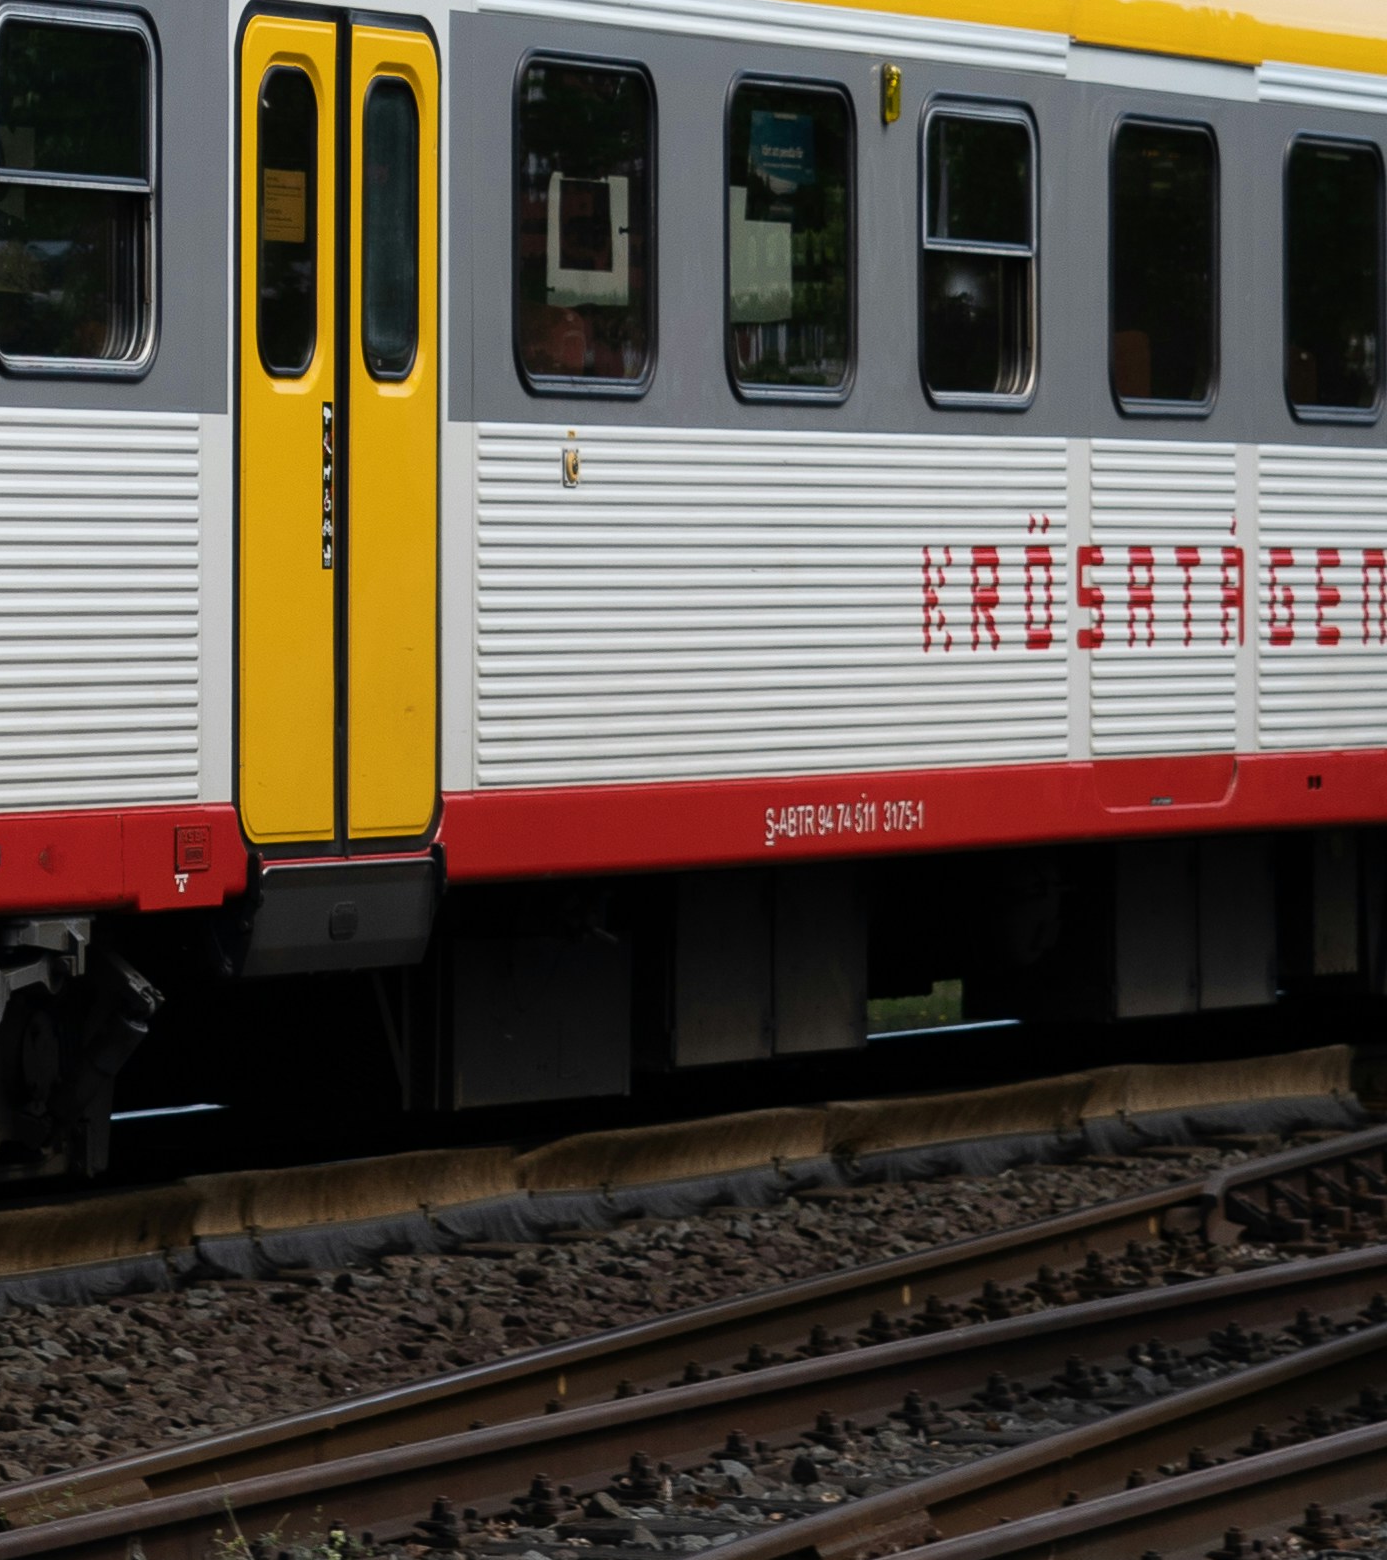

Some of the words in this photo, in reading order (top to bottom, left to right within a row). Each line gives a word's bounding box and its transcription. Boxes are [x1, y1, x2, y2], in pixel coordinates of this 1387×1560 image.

[922, 513, 1386, 652] KRÖSATÅGEN
[818, 804, 834, 836] 94
[836, 803, 852, 833] 74
[854, 801, 877, 833] 511
[883, 800, 924, 832] 3175-1
